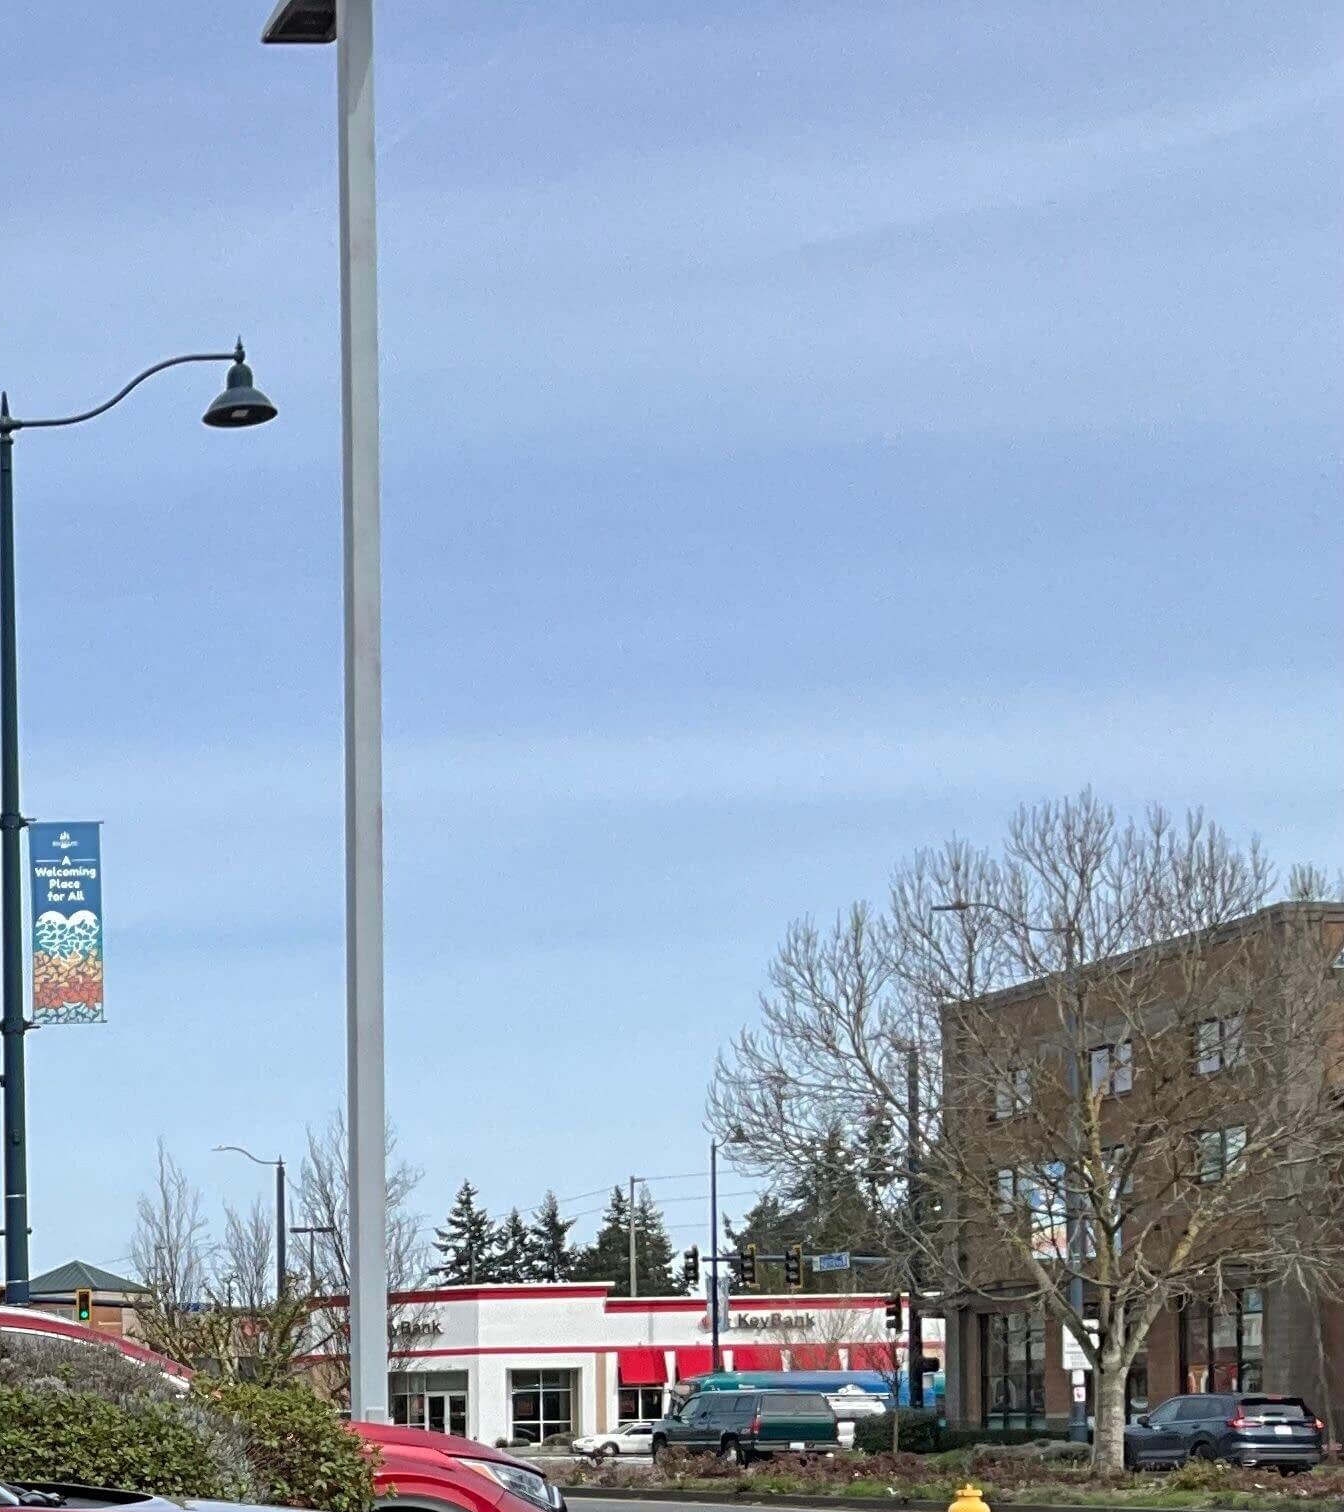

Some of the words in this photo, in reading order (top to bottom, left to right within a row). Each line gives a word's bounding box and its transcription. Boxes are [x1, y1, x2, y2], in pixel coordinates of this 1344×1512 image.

[61, 855, 72, 866] A
[34, 866, 97, 879] Welcoming
[49, 878, 81, 889] Place
[47, 890, 66, 902] for
[67, 889, 85, 901] All
[738, 1313, 814, 1330] KeyBank
